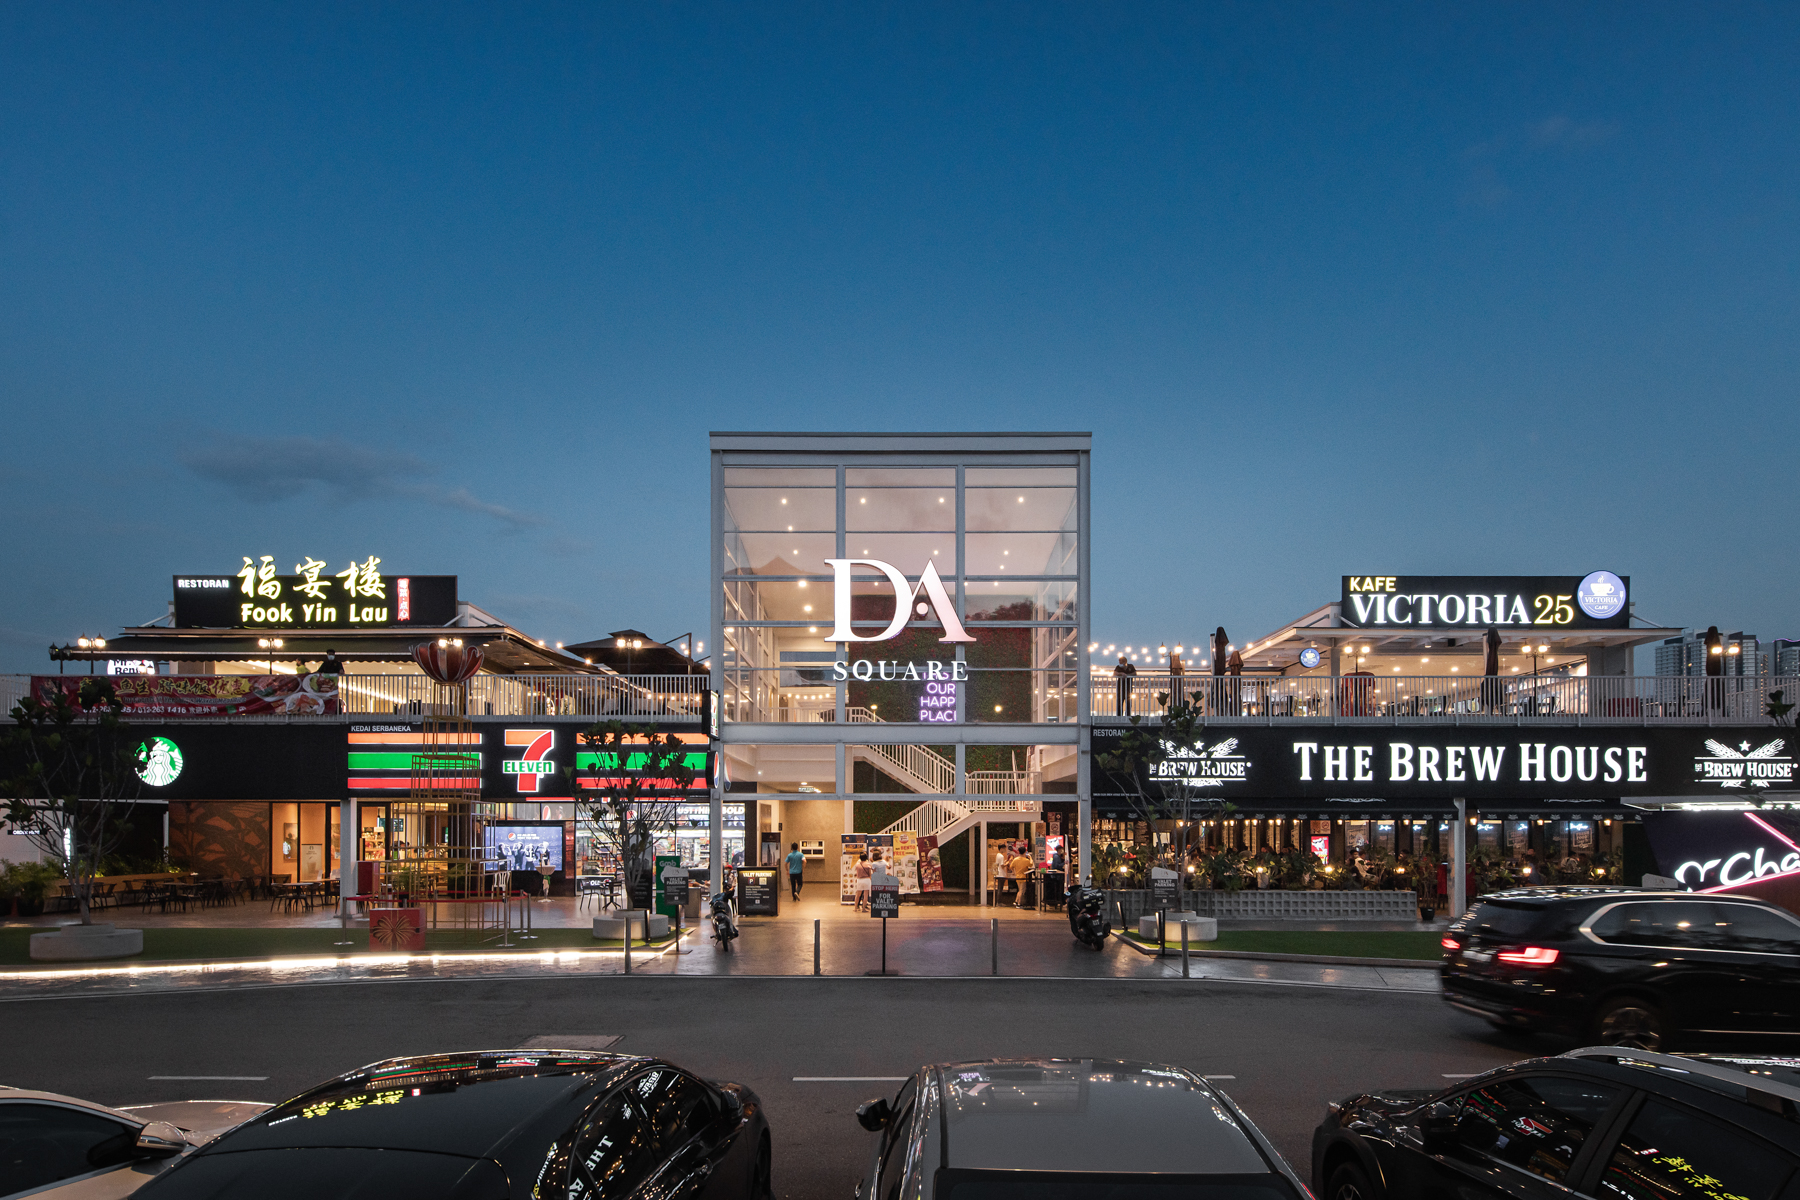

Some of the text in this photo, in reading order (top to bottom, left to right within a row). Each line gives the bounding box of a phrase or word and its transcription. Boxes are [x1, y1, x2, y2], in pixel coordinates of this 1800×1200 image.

[178, 579, 229, 588] RESTORAN
[237, 555, 386, 599] 福宴楼
[1350, 577, 1396, 592] KAFE
[824, 558, 977, 642] DA
[1350, 594, 1574, 625] VICTORIA 25
[241, 603, 388, 622] Fook Yin Lau
[833, 660, 969, 682] SQUARE
[926, 682, 956, 695] OUR
[920, 696, 956, 707] HAPP
[1293, 742, 1648, 783] THE BREW HOUSE
[1703, 761, 1745, 777] BREW
[1746, 761, 1793, 777] HOUSE
